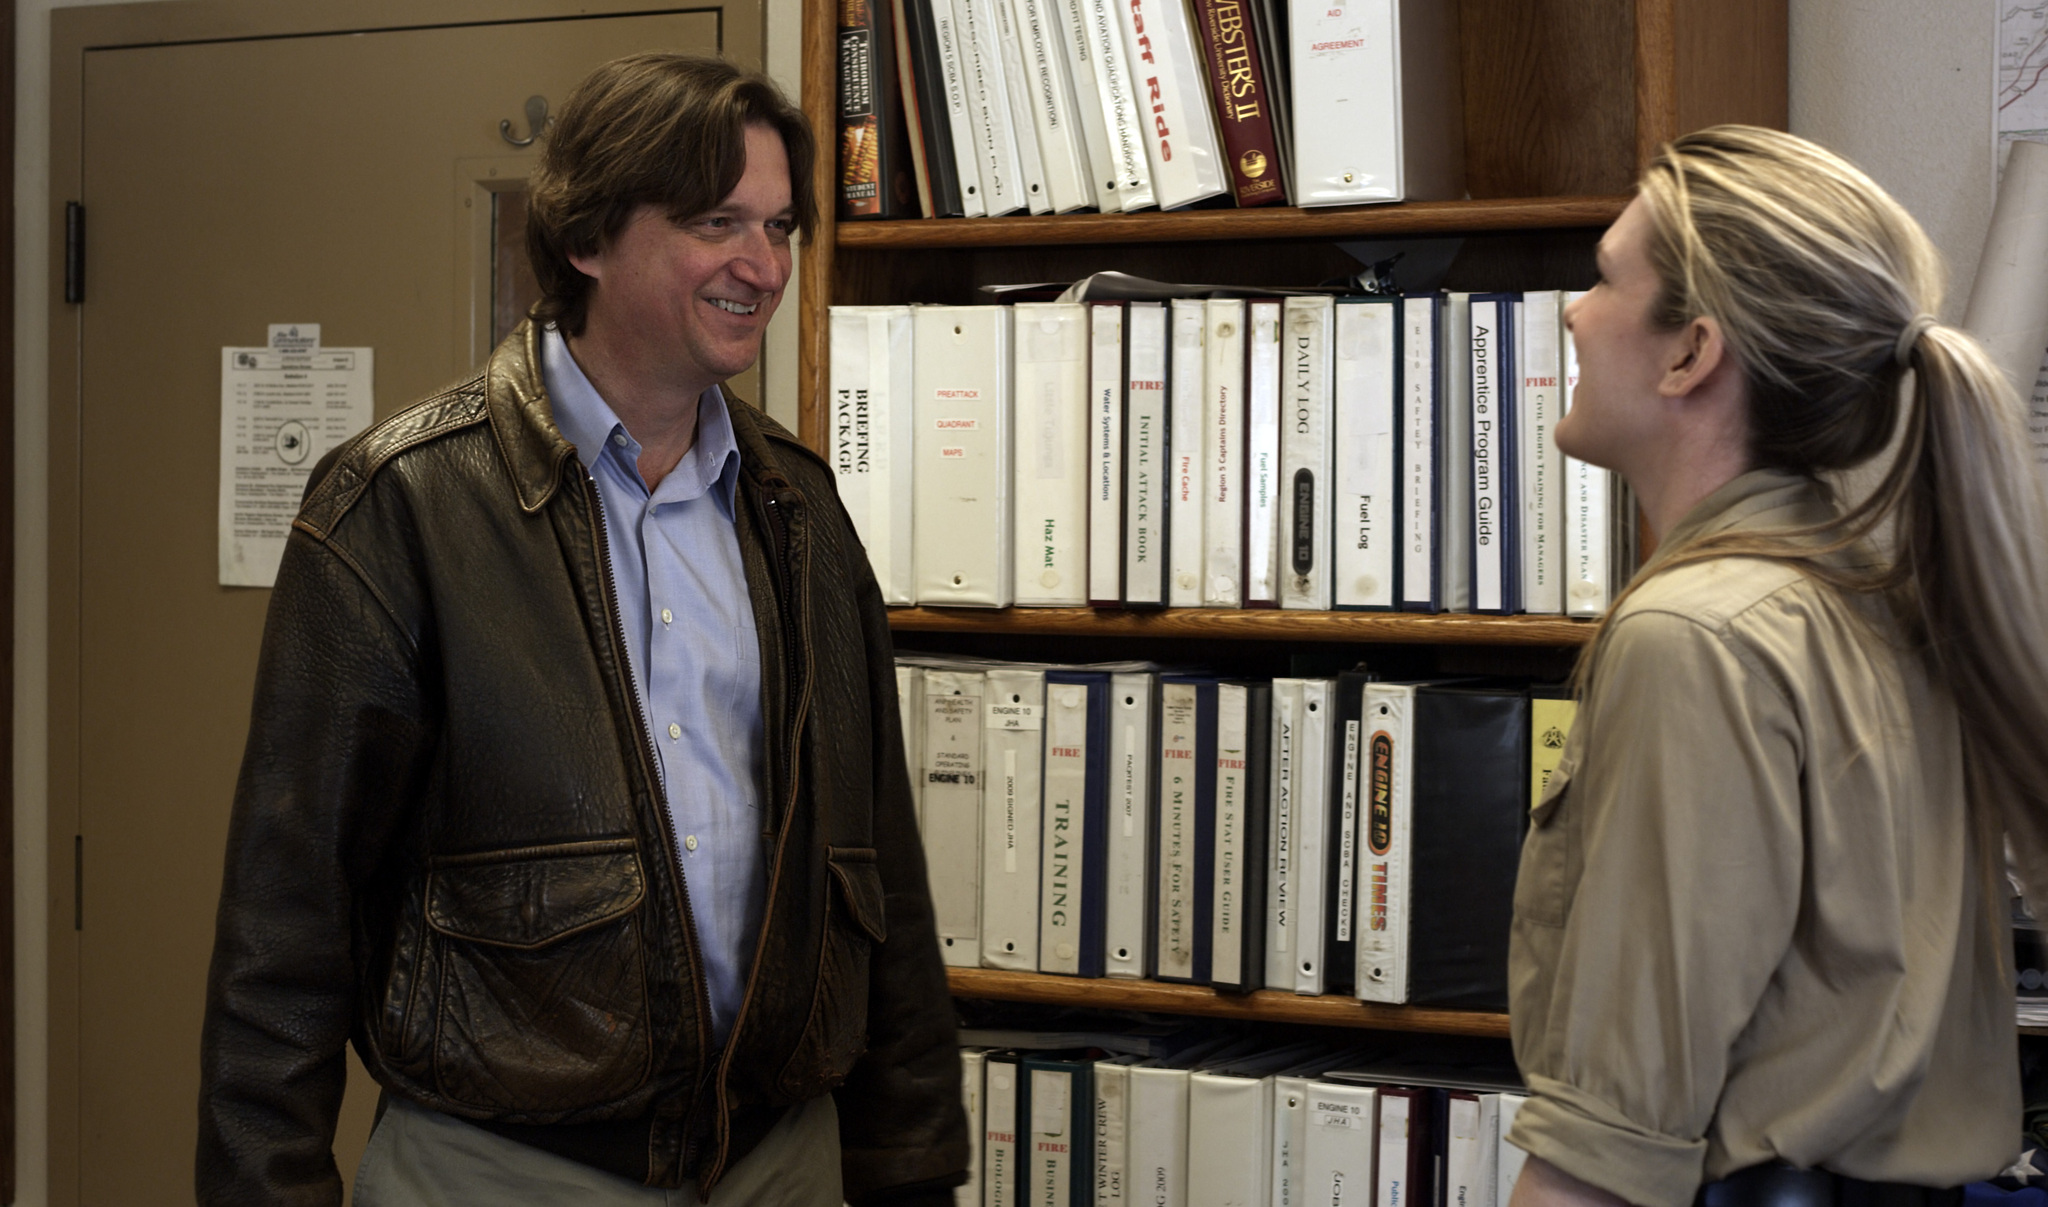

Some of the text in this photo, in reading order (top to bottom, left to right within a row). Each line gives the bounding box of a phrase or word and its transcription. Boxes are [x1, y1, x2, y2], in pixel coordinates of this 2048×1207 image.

[1072, 11, 1080, 24] FIT
[1327, 9, 1342, 17] AID
[941, 20, 951, 53] REGION
[1074, 25, 1087, 62] TESTING
[1098, 12, 1112, 54] AVIATION
[1311, 39, 1365, 51] AGREEMENT
[843, 39, 852, 111] MANAGEMENT
[851, 35, 861, 112] CONSEQUENCE
[859, 40, 869, 105] TERRORISM
[945, 62, 957, 84] SCBA
[1031, 16, 1046, 64] EMPLOYEE
[1041, 66, 1057, 126] RECOGNITION
[1130, 0, 1172, 163] taff Ride
[1206, 8, 1220, 43] Riverside
[1214, 43, 1227, 80] University
[1221, 81, 1235, 119] Dictionary
[1104, 55, 1124, 127] QUALIFICATIONS
[1235, 100, 1260, 122] II
[983, 106, 994, 149] BURN
[991, 155, 1002, 196] PLAN
[846, 183, 875, 192] STUDENT
[846, 190, 876, 199] MANUAL
[937, 390, 978, 398] PREATTACK
[1130, 381, 1164, 391] FIRE
[1297, 337, 1310, 435] DAILY LOG
[1525, 377, 1557, 387] FIRE
[1103, 388, 1111, 414] Water
[1219, 386, 1228, 426] Directory
[1414, 383, 1422, 450] SAFETY
[1536, 394, 1544, 421] CIVIL
[838, 389, 851, 475] PACKAGE
[856, 389, 869, 474] BRIEFING
[937, 420, 975, 429] QUADRANT
[1101, 416, 1110, 449] Systems
[1473, 325, 1493, 547] Apprentice Program Guide
[1536, 425, 1544, 460] RIGHTS
[943, 449, 963, 457] MAPS
[1219, 428, 1228, 464] Captains
[1102, 461, 1110, 501] Locations
[1137, 415, 1151, 563] INITIAL ATTACK BOOK
[1181, 456, 1190, 502] Fire Cache
[1219, 474, 1227, 502] Region
[1259, 475, 1268, 508] Samples
[1536, 463, 1544, 509] TRAINING
[1580, 484, 1588, 502] AND
[1298, 482, 1311, 561] ENGINE 10
[1357, 495, 1371, 550] Fuel Log
[1414, 463, 1422, 553] BRIEFING
[1044, 519, 1055, 568] Haz Mat
[1580, 506, 1588, 551] DISASTER
[1537, 534, 1545, 586] MANAGERS
[992, 707, 1031, 715] ENGINE 10
[1052, 747, 1080, 758] FIRE
[1164, 749, 1192, 759] FIRE
[1218, 759, 1245, 770] FIRE
[929, 773, 975, 784] ENGINE 10
[1006, 776, 1014, 796] 2009
[1373, 741, 1389, 844] ENGINE 10
[1006, 799, 1014, 831] SIGNED
[1278, 724, 1290, 927] AFTER ACTION REVIEW
[1340, 723, 1355, 936] ENGINE AND SCBA CHECKS
[1052, 799, 1070, 927] TRAINING
[1171, 776, 1183, 954] 6 MINUTES FOR SAFETY
[1222, 776, 1235, 934] FIRE STAT USER GUIDE
[1370, 861, 1388, 931] TIMES
[1098, 1098, 1107, 1139] CREW
[1318, 1102, 1360, 1115] ENGINE 10
[1328, 1116, 1347, 1126] JHA
[988, 1131, 1015, 1143] FIRE
[1038, 1142, 1067, 1153] FIRE
[1046, 1160, 1056, 1207] BUSINE
[1098, 1141, 1107, 1190] WINTER
[1156, 1167, 1165, 1192] 2009
[1112, 1171, 1120, 1198] LOG
[1391, 1181, 1399, 1207] Public
